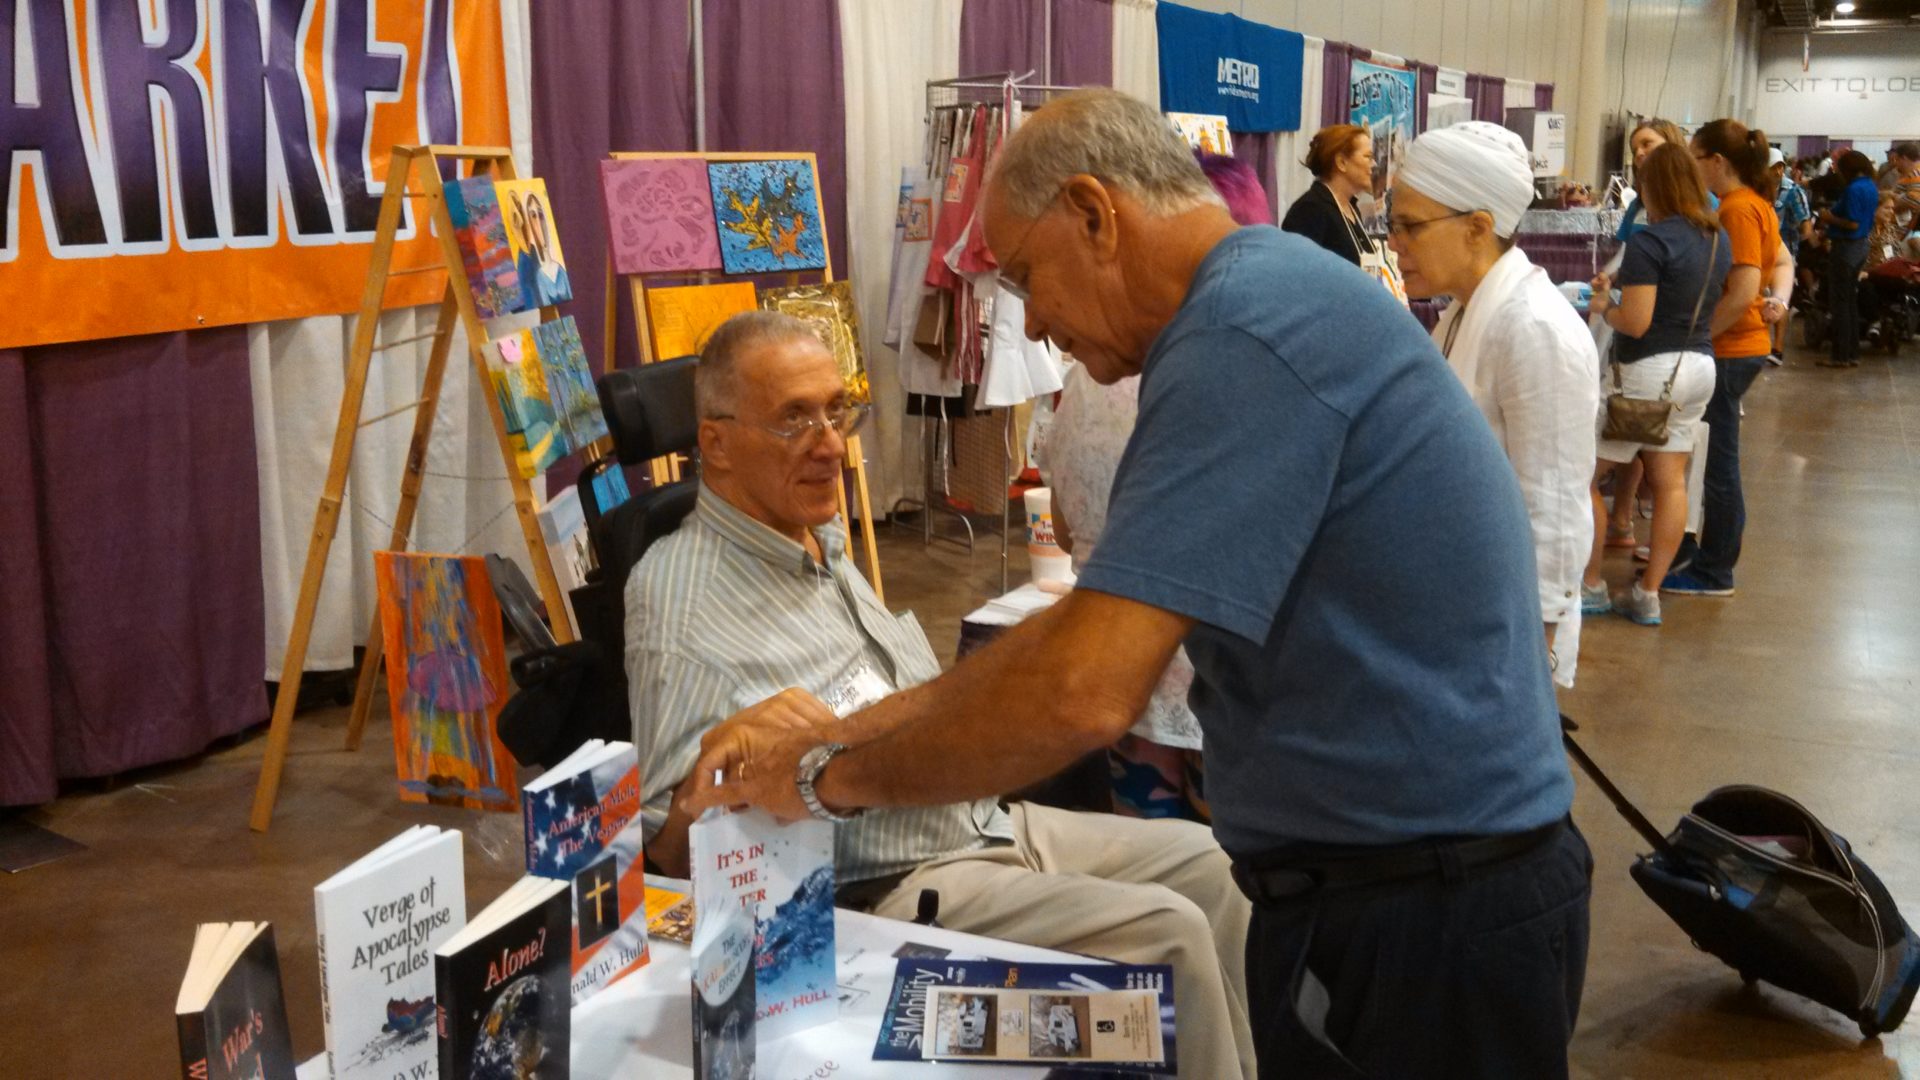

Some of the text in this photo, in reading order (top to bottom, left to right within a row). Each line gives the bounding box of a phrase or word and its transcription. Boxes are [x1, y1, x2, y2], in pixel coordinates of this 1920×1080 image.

[1217, 57, 1260, 90] METRO
[1765, 77, 1821, 93] EXIT
[1831, 77, 1867, 93] TO
[548, 803, 606, 839] American
[557, 837, 584, 858] The
[716, 843, 766, 871] IT'S IN
[730, 868, 759, 889] THE
[362, 876, 436, 929] Verge of
[351, 906, 451, 970] Apocalypse
[380, 943, 429, 986] Tales
[483, 927, 546, 992] Alone?
[570, 938, 645, 995] nald W. Hull
[793, 989, 832, 1009] HULL
[892, 967, 944, 1032] Mobility
